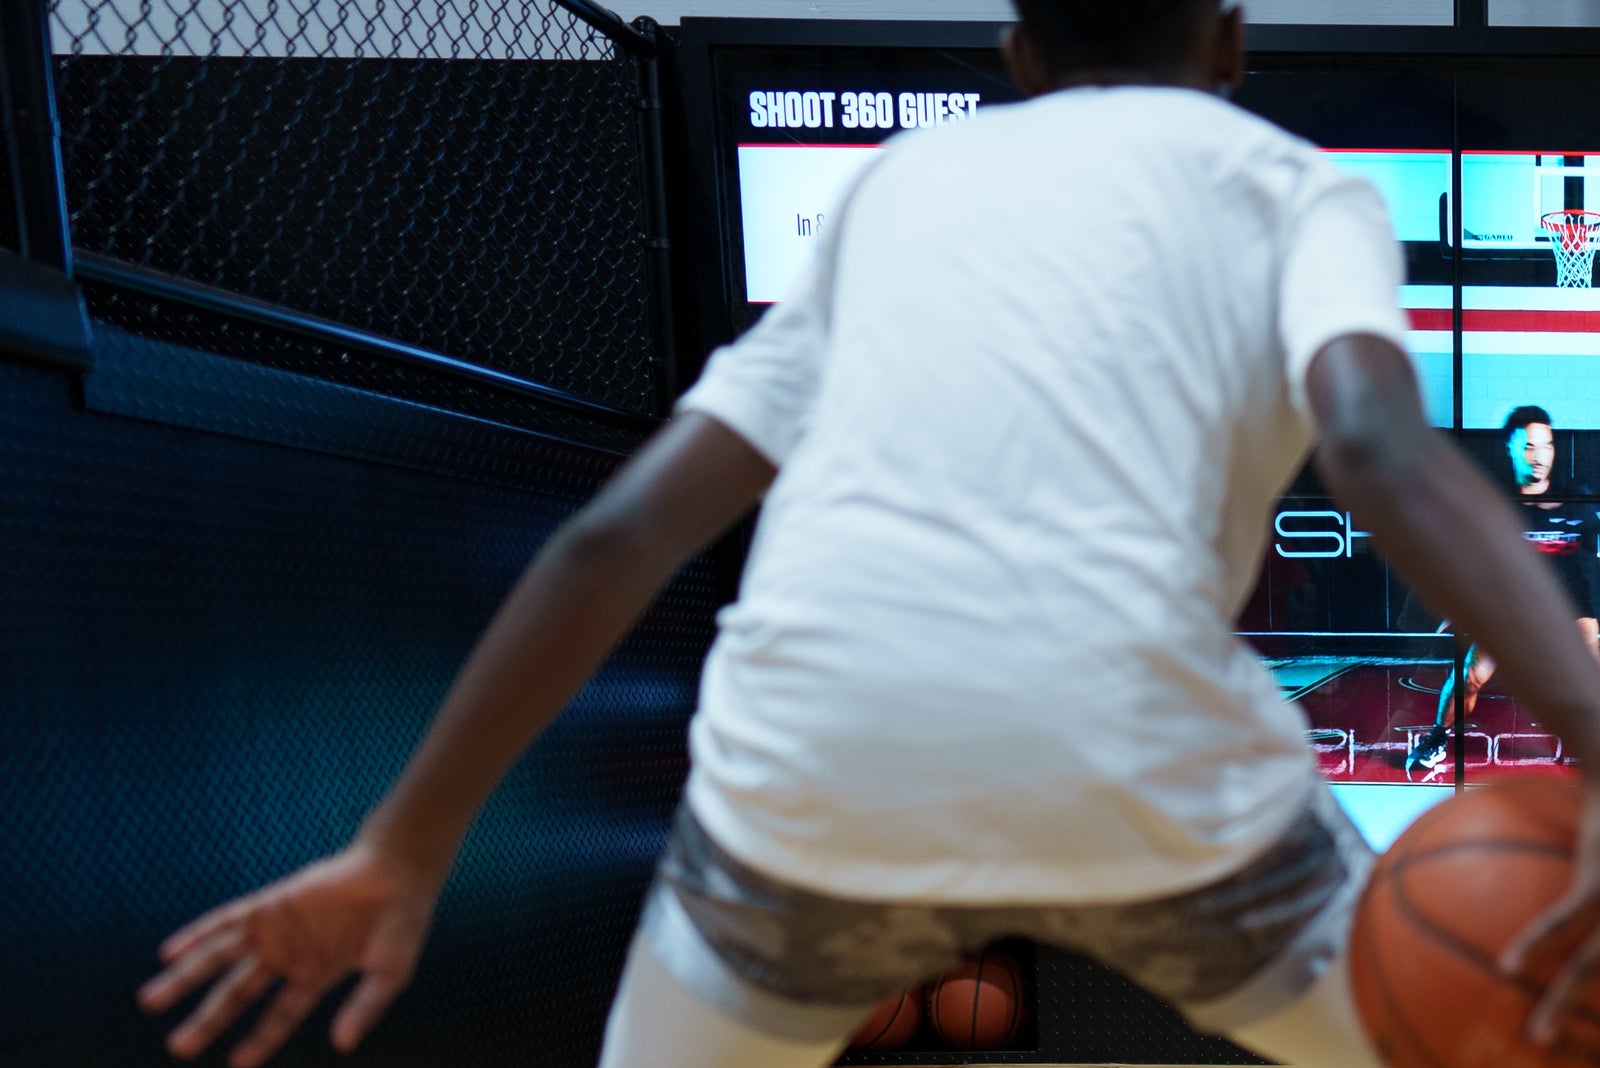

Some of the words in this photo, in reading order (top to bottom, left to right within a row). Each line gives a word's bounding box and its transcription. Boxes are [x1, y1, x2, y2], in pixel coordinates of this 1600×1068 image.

[749, 91, 835, 127] SHOOT
[841, 92, 893, 128] 360
[898, 93, 980, 128] GUEST
[797, 213, 811, 236] In
